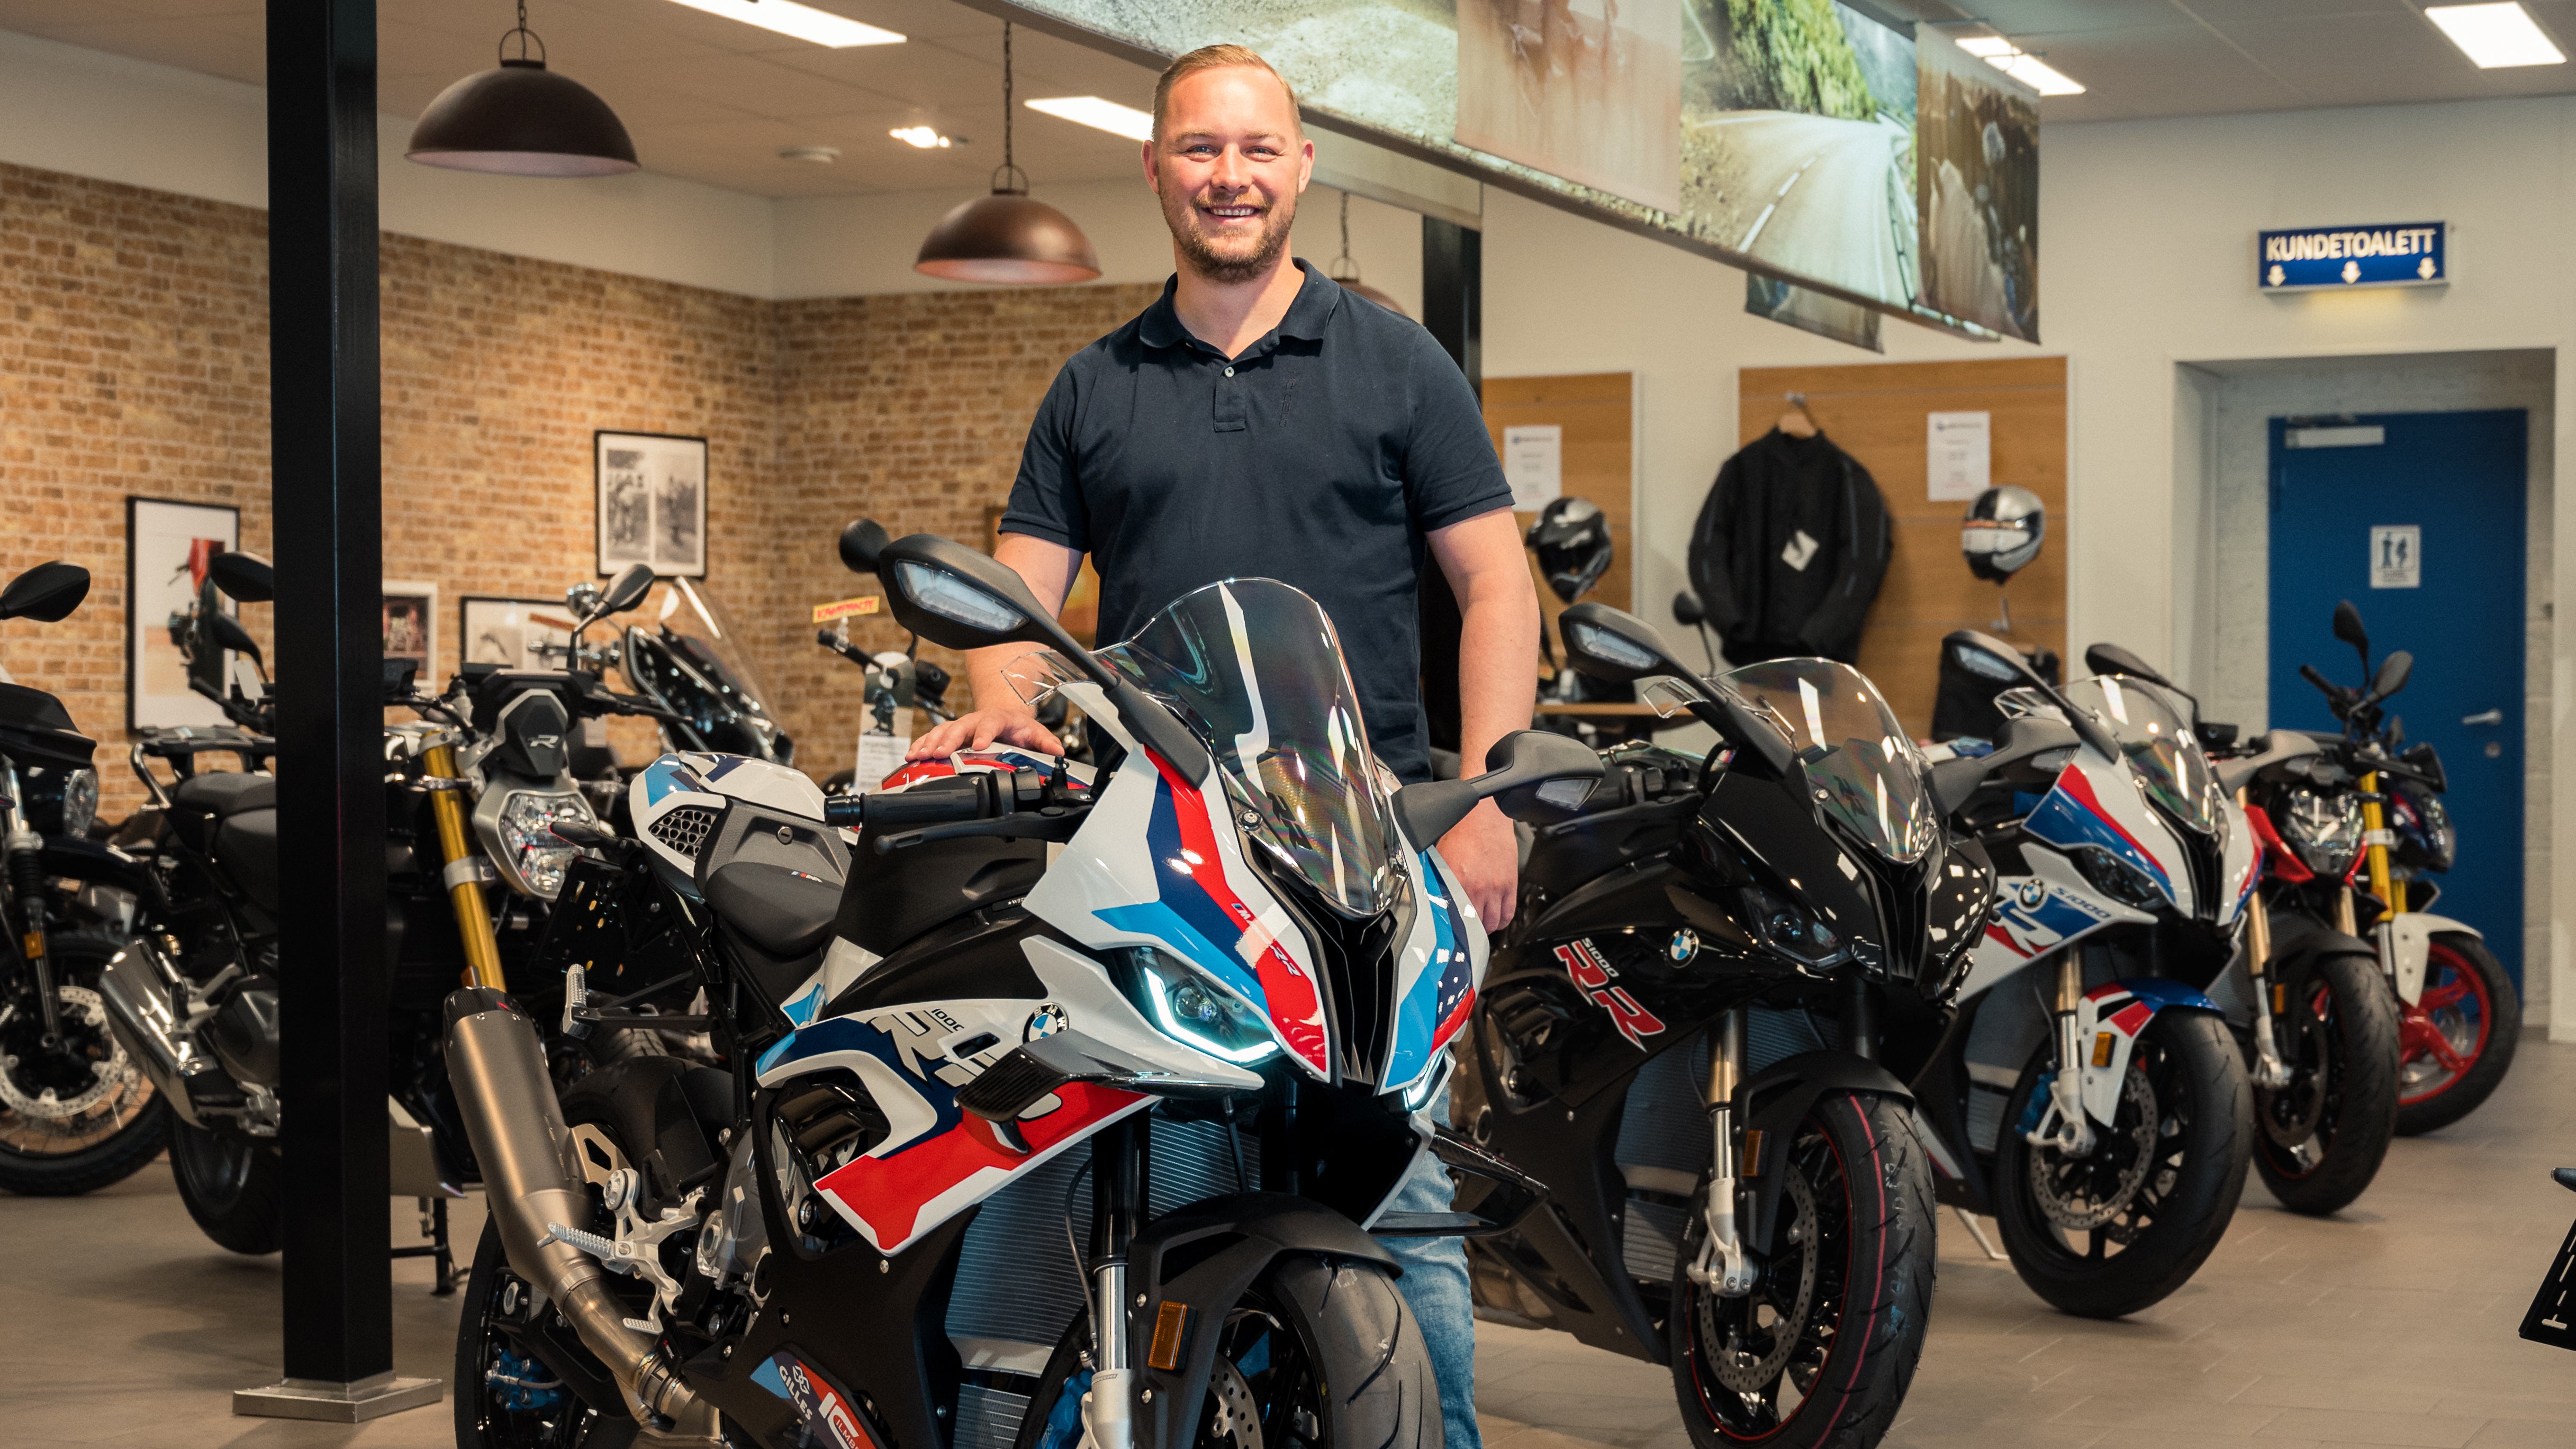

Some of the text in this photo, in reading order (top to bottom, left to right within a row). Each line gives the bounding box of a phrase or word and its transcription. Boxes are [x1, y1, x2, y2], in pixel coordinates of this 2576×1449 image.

[2266, 228, 2436, 262] KUNDETOALETT
[528, 734, 559, 749] R
[1265, 790, 1313, 850] RR
[1553, 940, 1666, 1053] RR
[779, 1365, 813, 1420] GILLES
